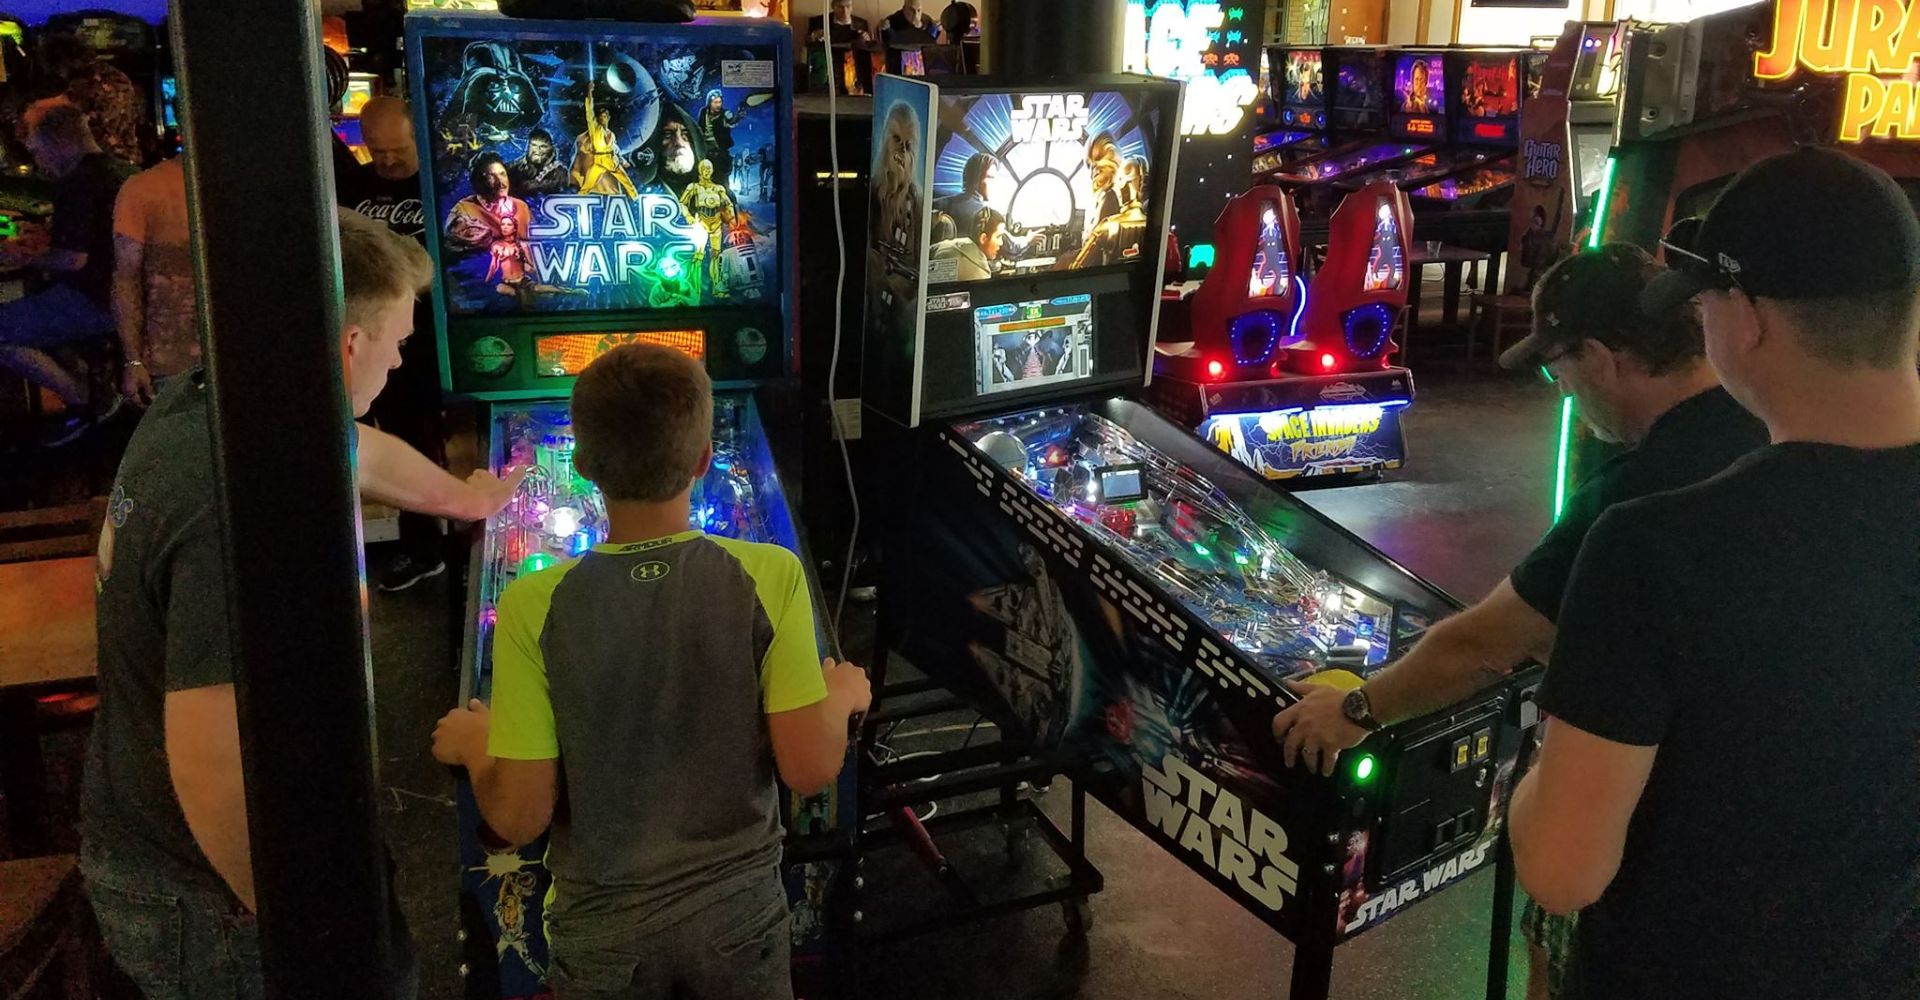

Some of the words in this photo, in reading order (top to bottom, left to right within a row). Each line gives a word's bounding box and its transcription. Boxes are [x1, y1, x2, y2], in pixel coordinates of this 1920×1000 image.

[1010, 94, 1089, 119] STAR
[1011, 117, 1089, 142] WARS
[1840, 73, 1920, 141] PA
[528, 194, 699, 238] STAR
[1261, 412, 1310, 440] SPACE
[1309, 405, 1382, 437] INVADERS
[1142, 753, 1299, 881] STAR
[1142, 777, 1297, 911] WARS
[1345, 879, 1420, 934] STAR
[1423, 840, 1491, 893] WARS
